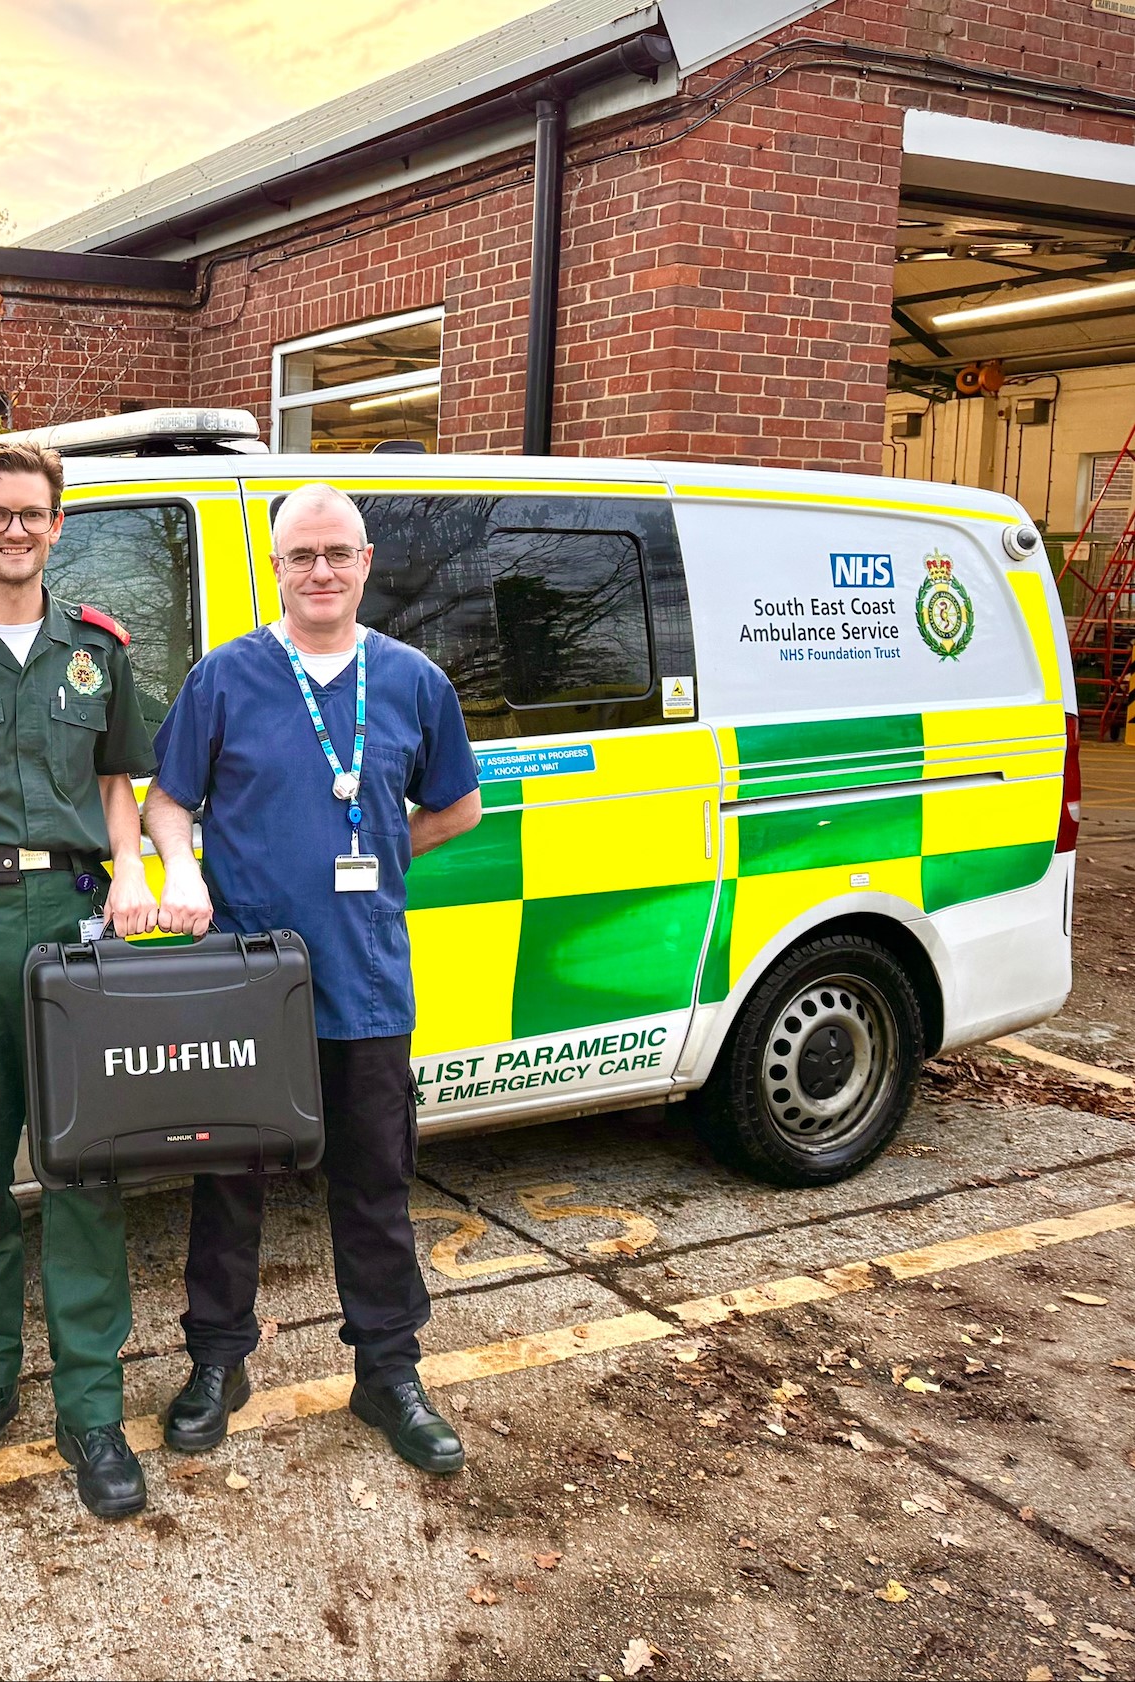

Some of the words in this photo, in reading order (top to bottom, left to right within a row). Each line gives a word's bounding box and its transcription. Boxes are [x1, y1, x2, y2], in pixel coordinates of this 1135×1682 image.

[833, 556, 891, 586] NHS
[754, 598, 805, 616] South
[811, 598, 846, 616] East
[851, 597, 896, 615] Coast
[739, 623, 836, 643] Ambulance
[842, 622, 899, 640] Service
[779, 648, 804, 661] NHS
[808, 647, 871, 661] Foundation
[873, 646, 901, 660] Trust
[487, 753, 536, 766] ASSESSMENT
[538, 752, 547, 761] IN
[548, 749, 589, 760] PROGRESS
[494, 766, 522, 776] KNOCK
[524, 764, 540, 773] AND
[541, 762, 560, 771] WAIT
[104, 1038, 257, 1077] FUJIFILM
[417, 1057, 485, 1085] LIST
[495, 1027, 668, 1074] PARAMEDIC
[437, 1063, 591, 1103] EMERGENCY
[599, 1051, 663, 1077] CARE
[166, 1134, 193, 1142] NANUK
